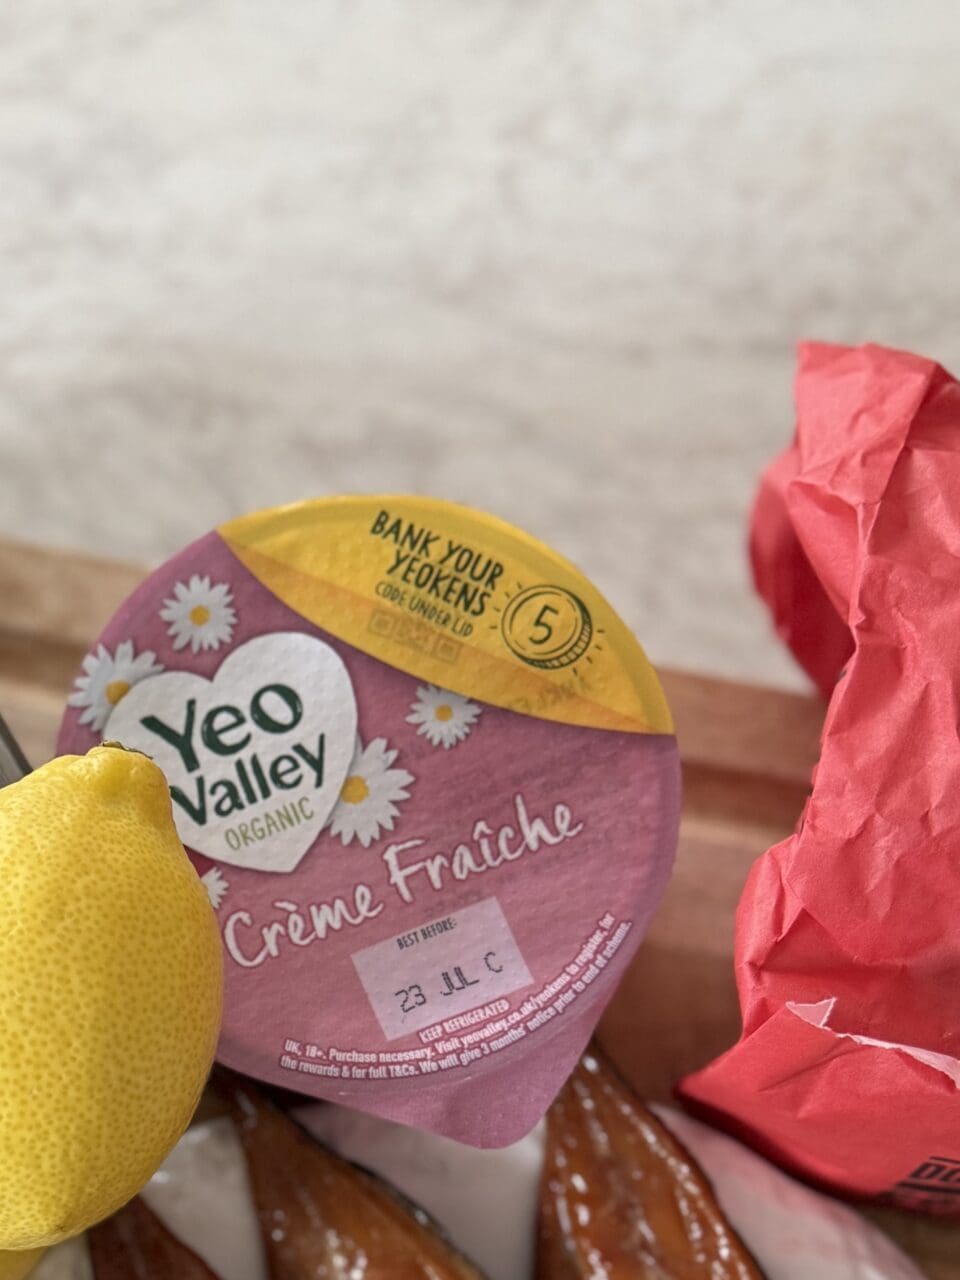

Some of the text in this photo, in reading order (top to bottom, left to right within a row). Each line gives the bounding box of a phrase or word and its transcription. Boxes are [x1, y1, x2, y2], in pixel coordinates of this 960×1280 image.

[370, 509, 504, 591] BANK YOUR
[387, 550, 491, 617] YEOKENS
[375, 582, 474, 637] CODE UNDER LID
[528, 604, 559, 646] 5
[139, 683, 303, 773] Yeo
[169, 732, 325, 826] Valley
[224, 796, 315, 851] ORGANIC
[223, 795, 584, 968] Crème Fraîche
[396, 930, 420, 950] BEST
[280, 1055, 297, 1068] the
[298, 1060, 339, 1077] rewards
[341, 1065, 350, 1077] &
[352, 1065, 367, 1079] for
[368, 1065, 388, 1079] full
[389, 1065, 419, 1078] T&Cs.
[419, 1059, 439, 1074] We
[438, 1054, 459, 1069] will
[460, 1048, 482, 1065] give
[480, 1042, 490, 1055] 3
[526, 1006, 557, 1031] notice
[553, 989, 577, 1014] prior
[571, 980, 586, 992] to
[581, 964, 600, 984] end
[595, 954, 609, 968] of
[602, 922, 632, 958] scheme.
[284, 913, 615, 1063] UK, 18+. Purchase necessary. Visit yeovalley.co.uk/yeokens to register, for
[394, 984, 427, 1013] 23
[483, 951, 503, 973] C
[419, 999, 510, 1043] KEEP REFRIGERATED
